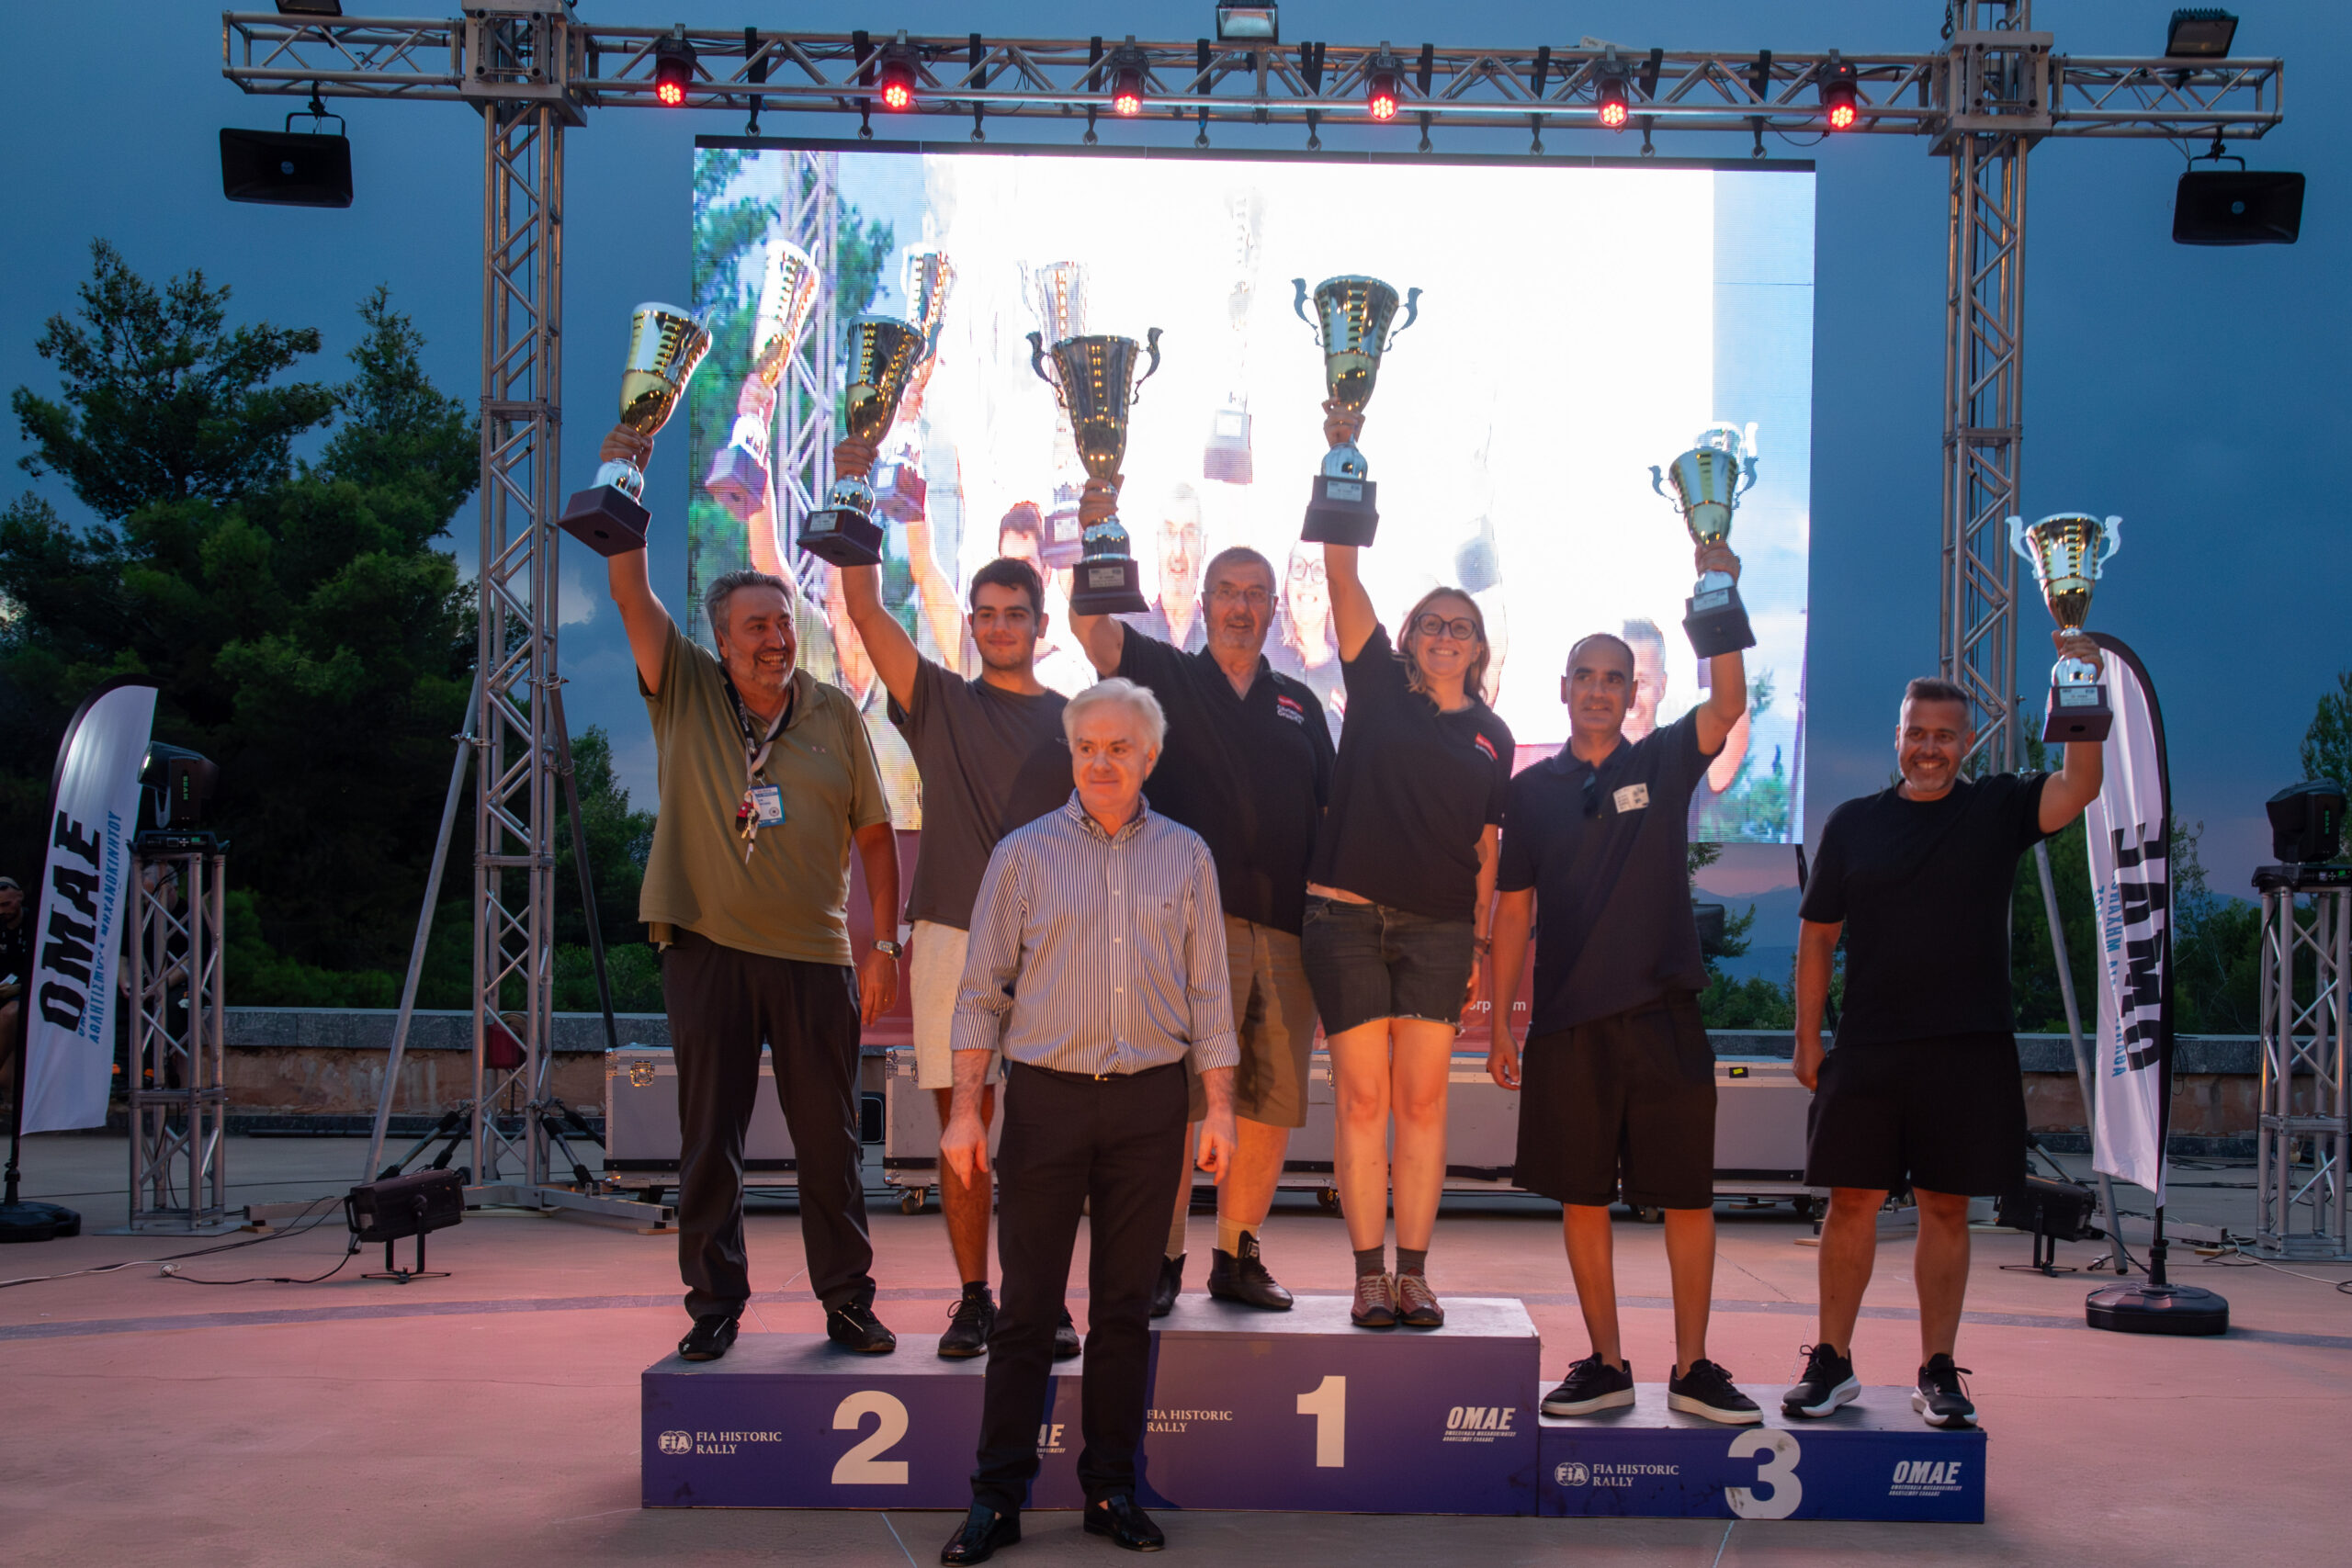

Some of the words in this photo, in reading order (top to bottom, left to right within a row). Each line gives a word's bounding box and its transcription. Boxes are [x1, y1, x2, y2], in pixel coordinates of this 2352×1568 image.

[1147, 1409, 1168, 1420] FIA
[1170, 1409, 1233, 1421] HISTORIC
[1147, 1422, 1188, 1433] RALLY
[1296, 1375, 1346, 1468] 1
[696, 1431, 717, 1442] FIA
[719, 1431, 782, 1442] HISTORIC
[831, 1390, 910, 1484] 2
[696, 1444, 738, 1454] RALLY
[1592, 1463, 1614, 1474] FIA
[1616, 1464, 1679, 1475] HISTORIC
[1724, 1428, 1803, 1519] 3
[1592, 1476, 1634, 1487] RALLY
